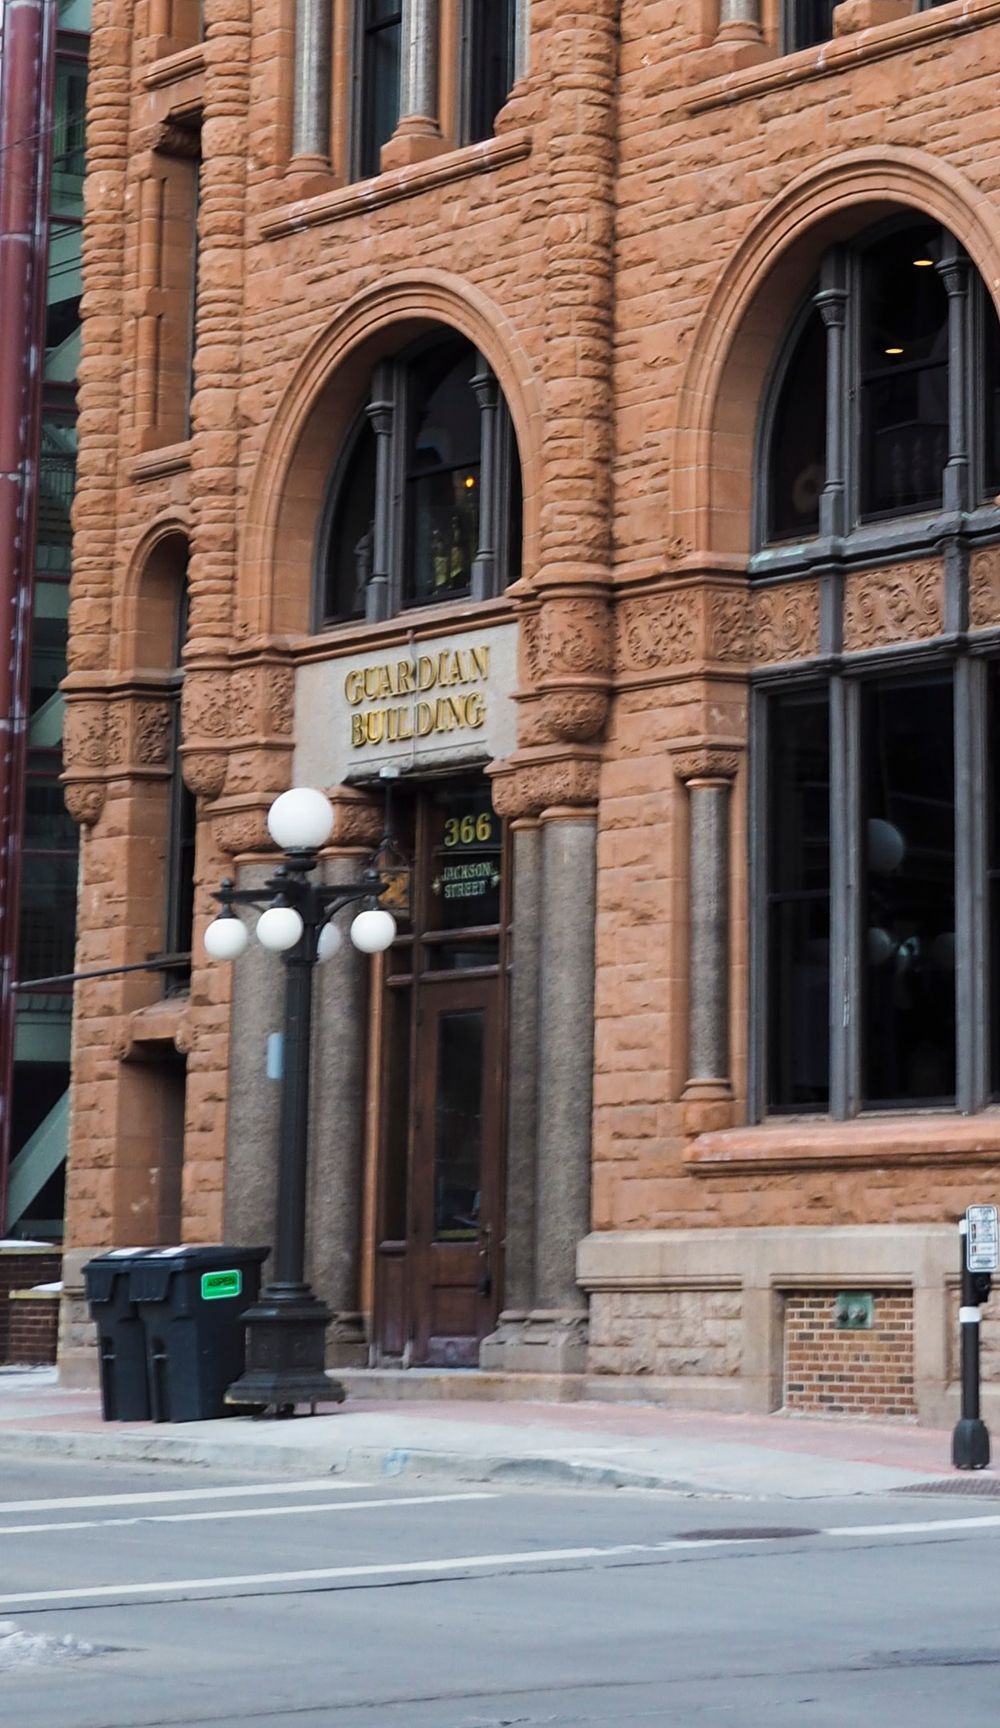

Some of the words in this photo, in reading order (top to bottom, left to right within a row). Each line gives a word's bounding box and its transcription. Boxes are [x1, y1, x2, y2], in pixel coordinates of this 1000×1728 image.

[344, 645, 490, 706] GUARDIAN
[351, 691, 487, 748] BUILDING
[444, 813, 491, 846] 366
[444, 880, 486, 899] STREET
